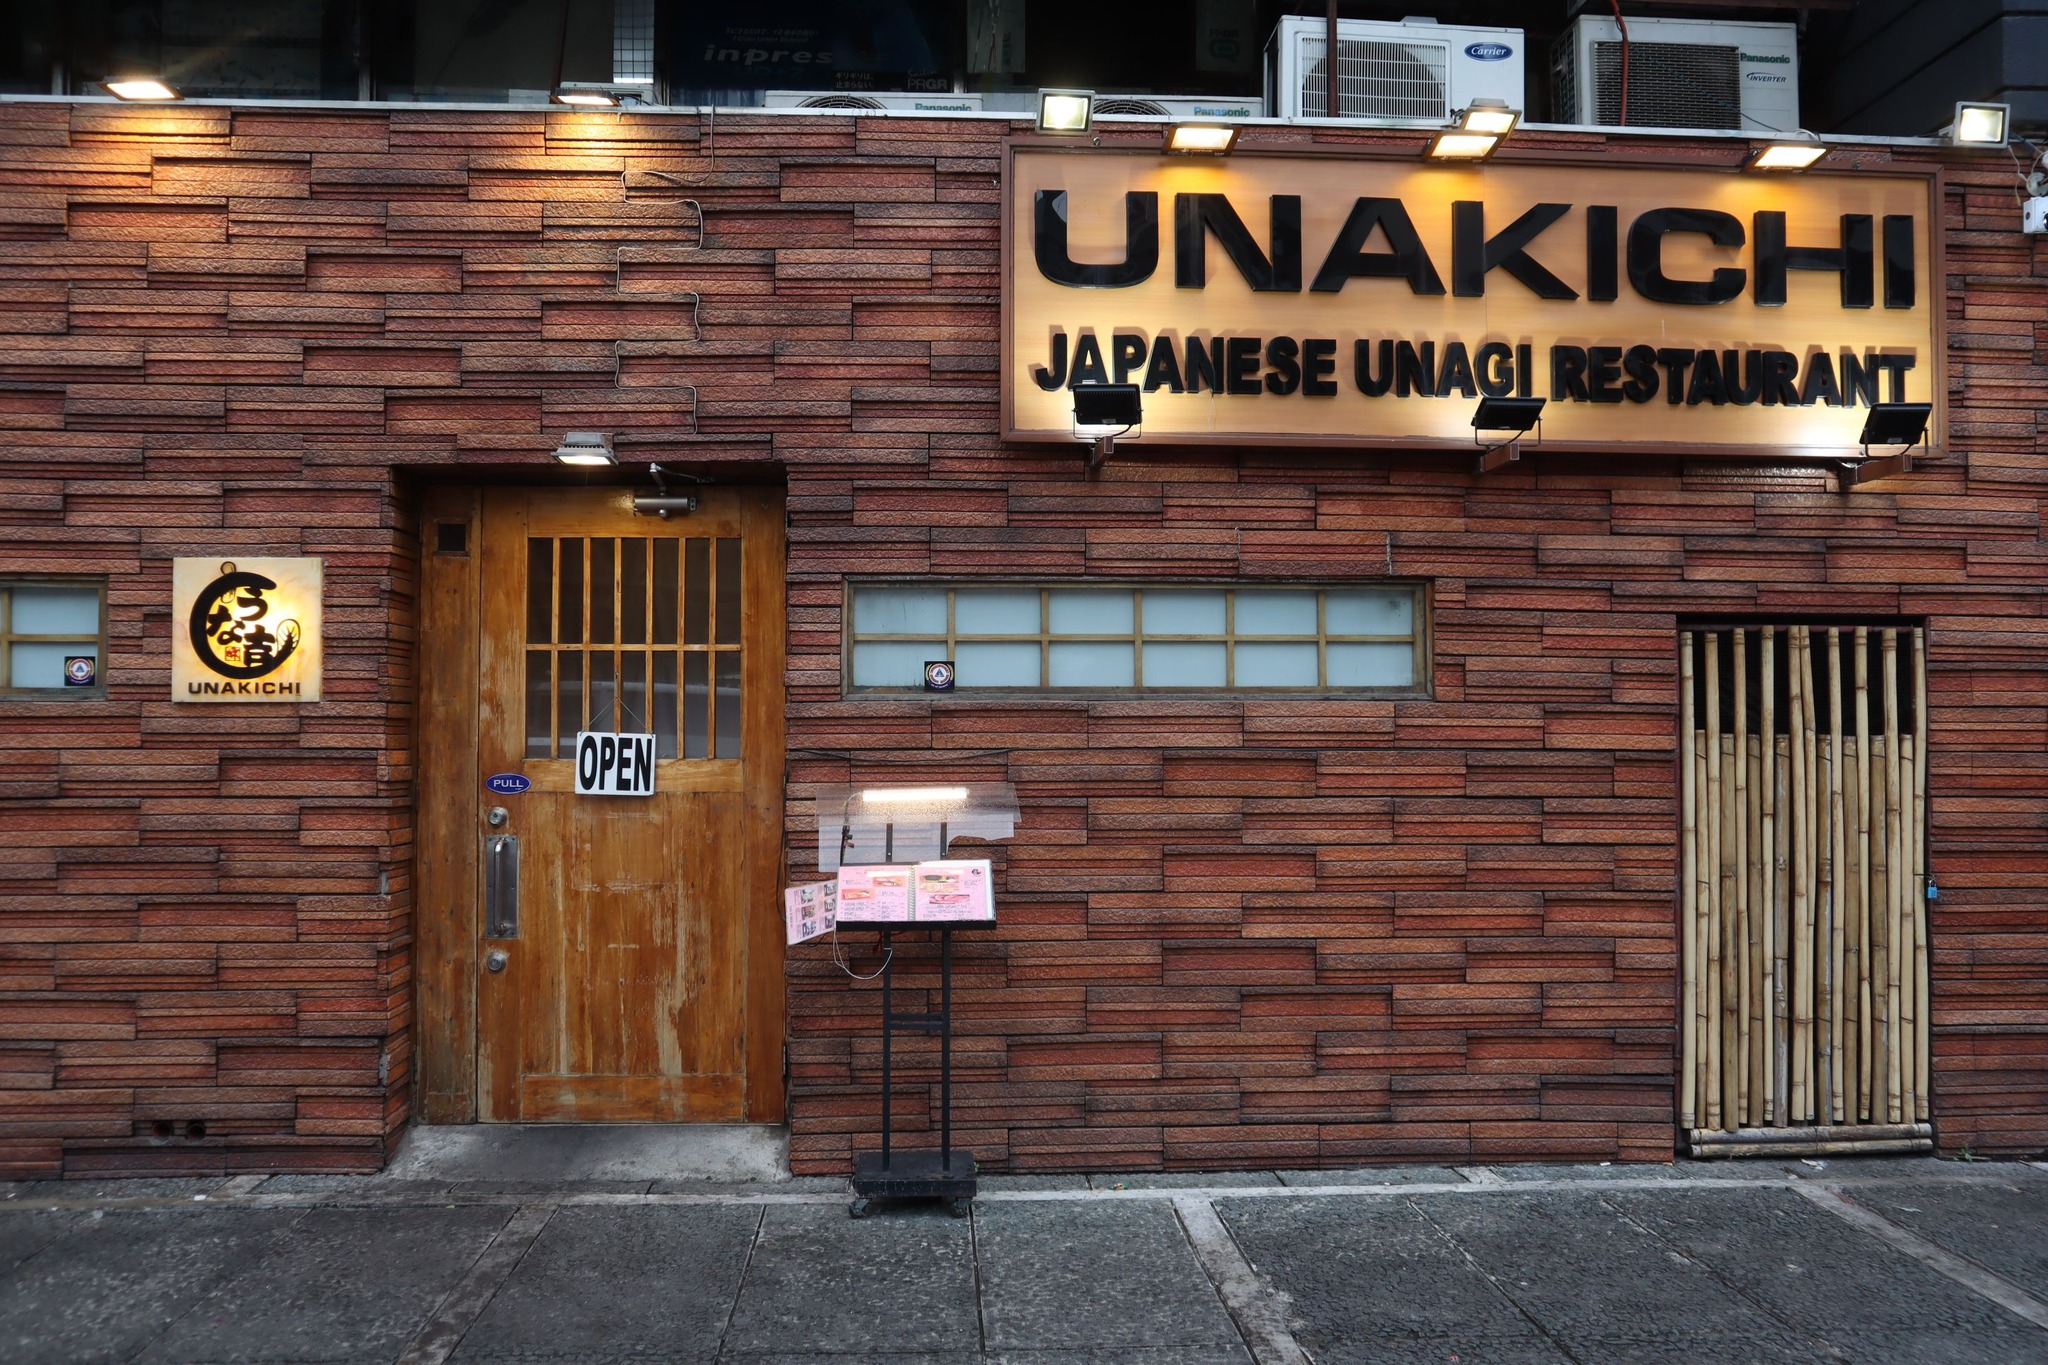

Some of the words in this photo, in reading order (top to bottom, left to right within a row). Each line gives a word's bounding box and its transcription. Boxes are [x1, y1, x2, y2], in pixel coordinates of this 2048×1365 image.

[704, 43, 833, 66] inpres
[1471, 46, 1507, 56] Carrier
[1740, 52, 1791, 64] Panasonic
[907, 78, 948, 90] PRGR
[1750, 75, 1787, 83] INVERTER
[1193, 106, 1251, 117] Panasonic
[1035, 190, 1915, 309] UNAKICHI
[1035, 333, 1338, 396] JAPANESE
[1355, 339, 1532, 398] UNAGI
[1551, 344, 1916, 408] RESTAURANT
[188, 682, 301, 695] UNAKICHI
[579, 735, 653, 791] OPEN
[493, 779, 524, 788] PULL
